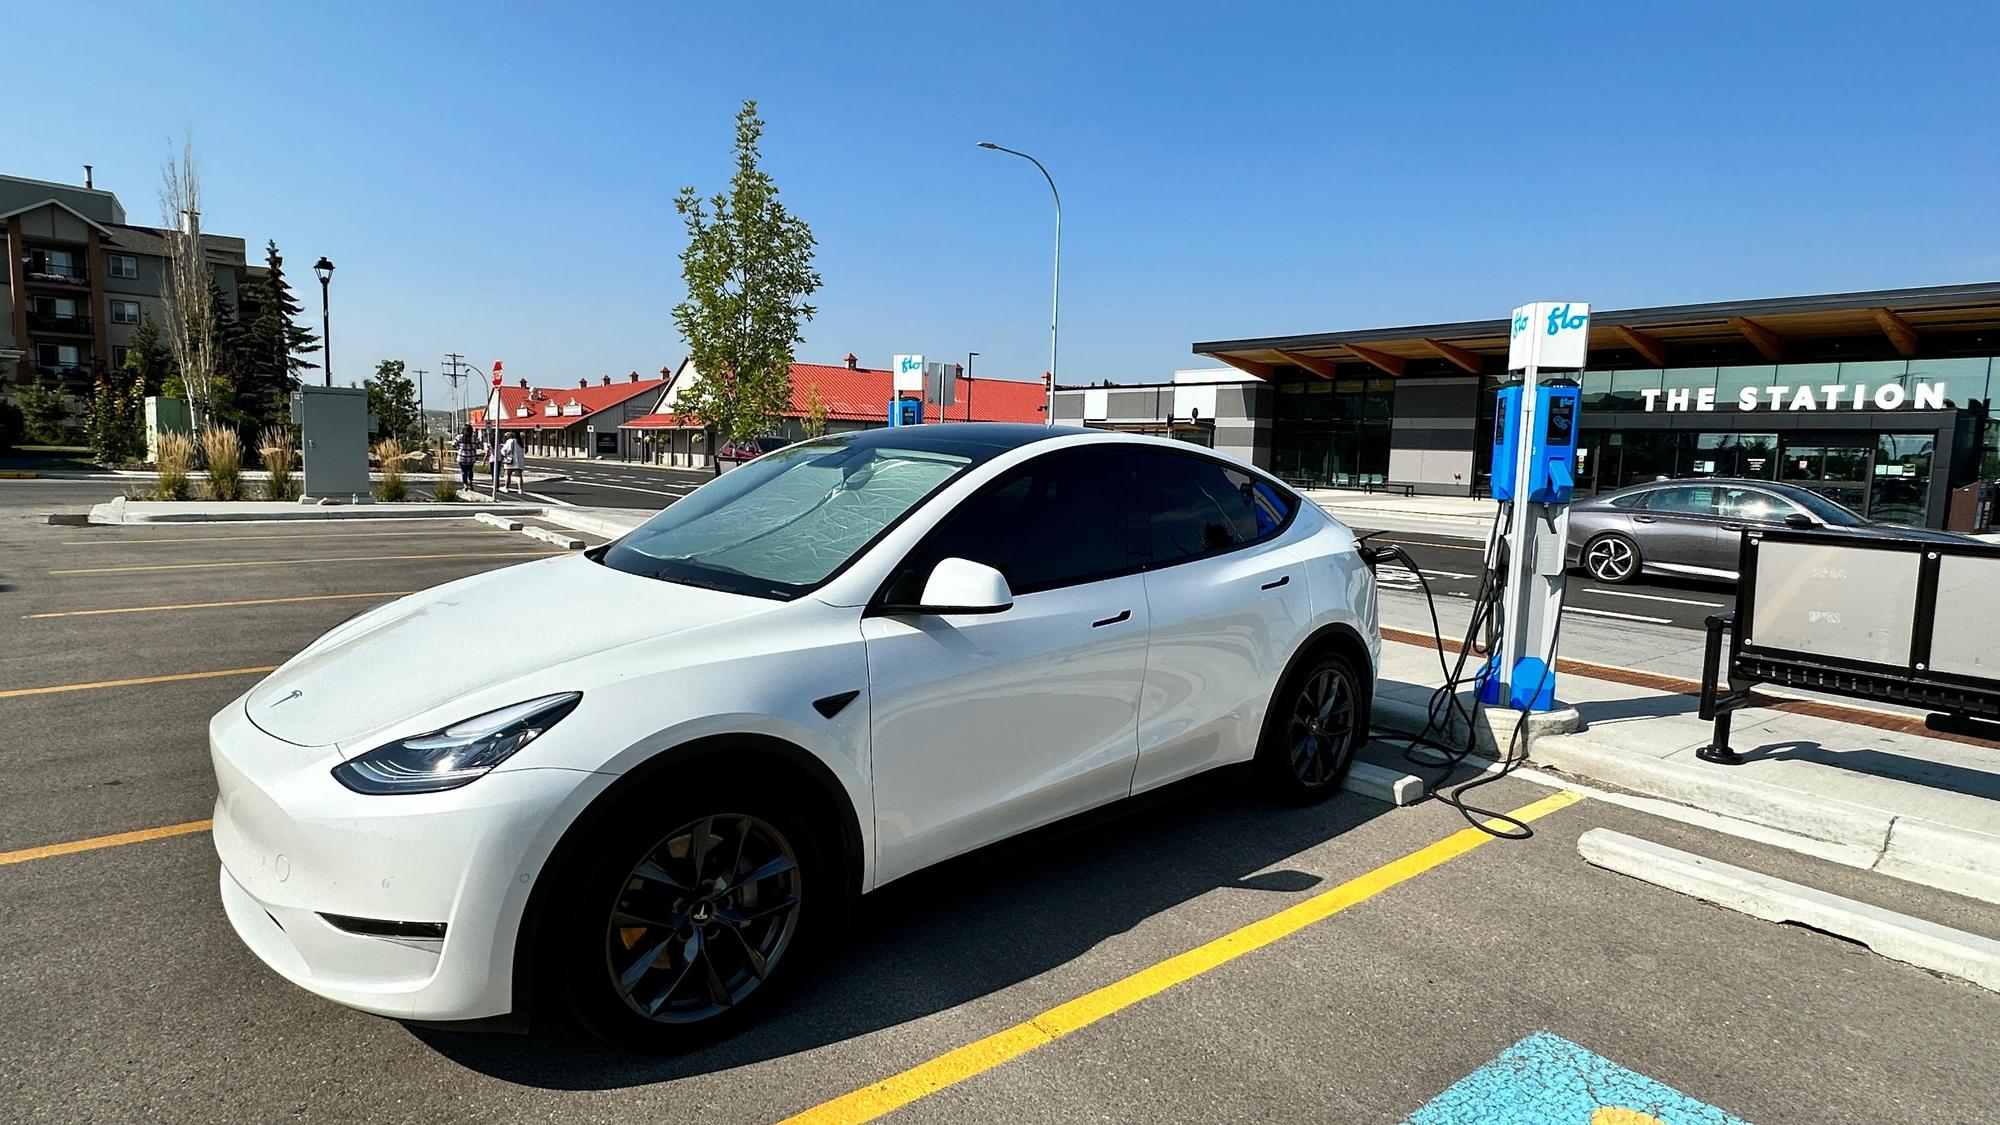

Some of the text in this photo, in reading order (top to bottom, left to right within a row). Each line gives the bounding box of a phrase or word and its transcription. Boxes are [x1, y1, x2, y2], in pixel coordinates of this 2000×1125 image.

[1513, 311, 1528, 339] flo
[1547, 303, 1588, 336] flo
[901, 356, 923, 373] flo
[1641, 382, 1946, 411] THE STATION
